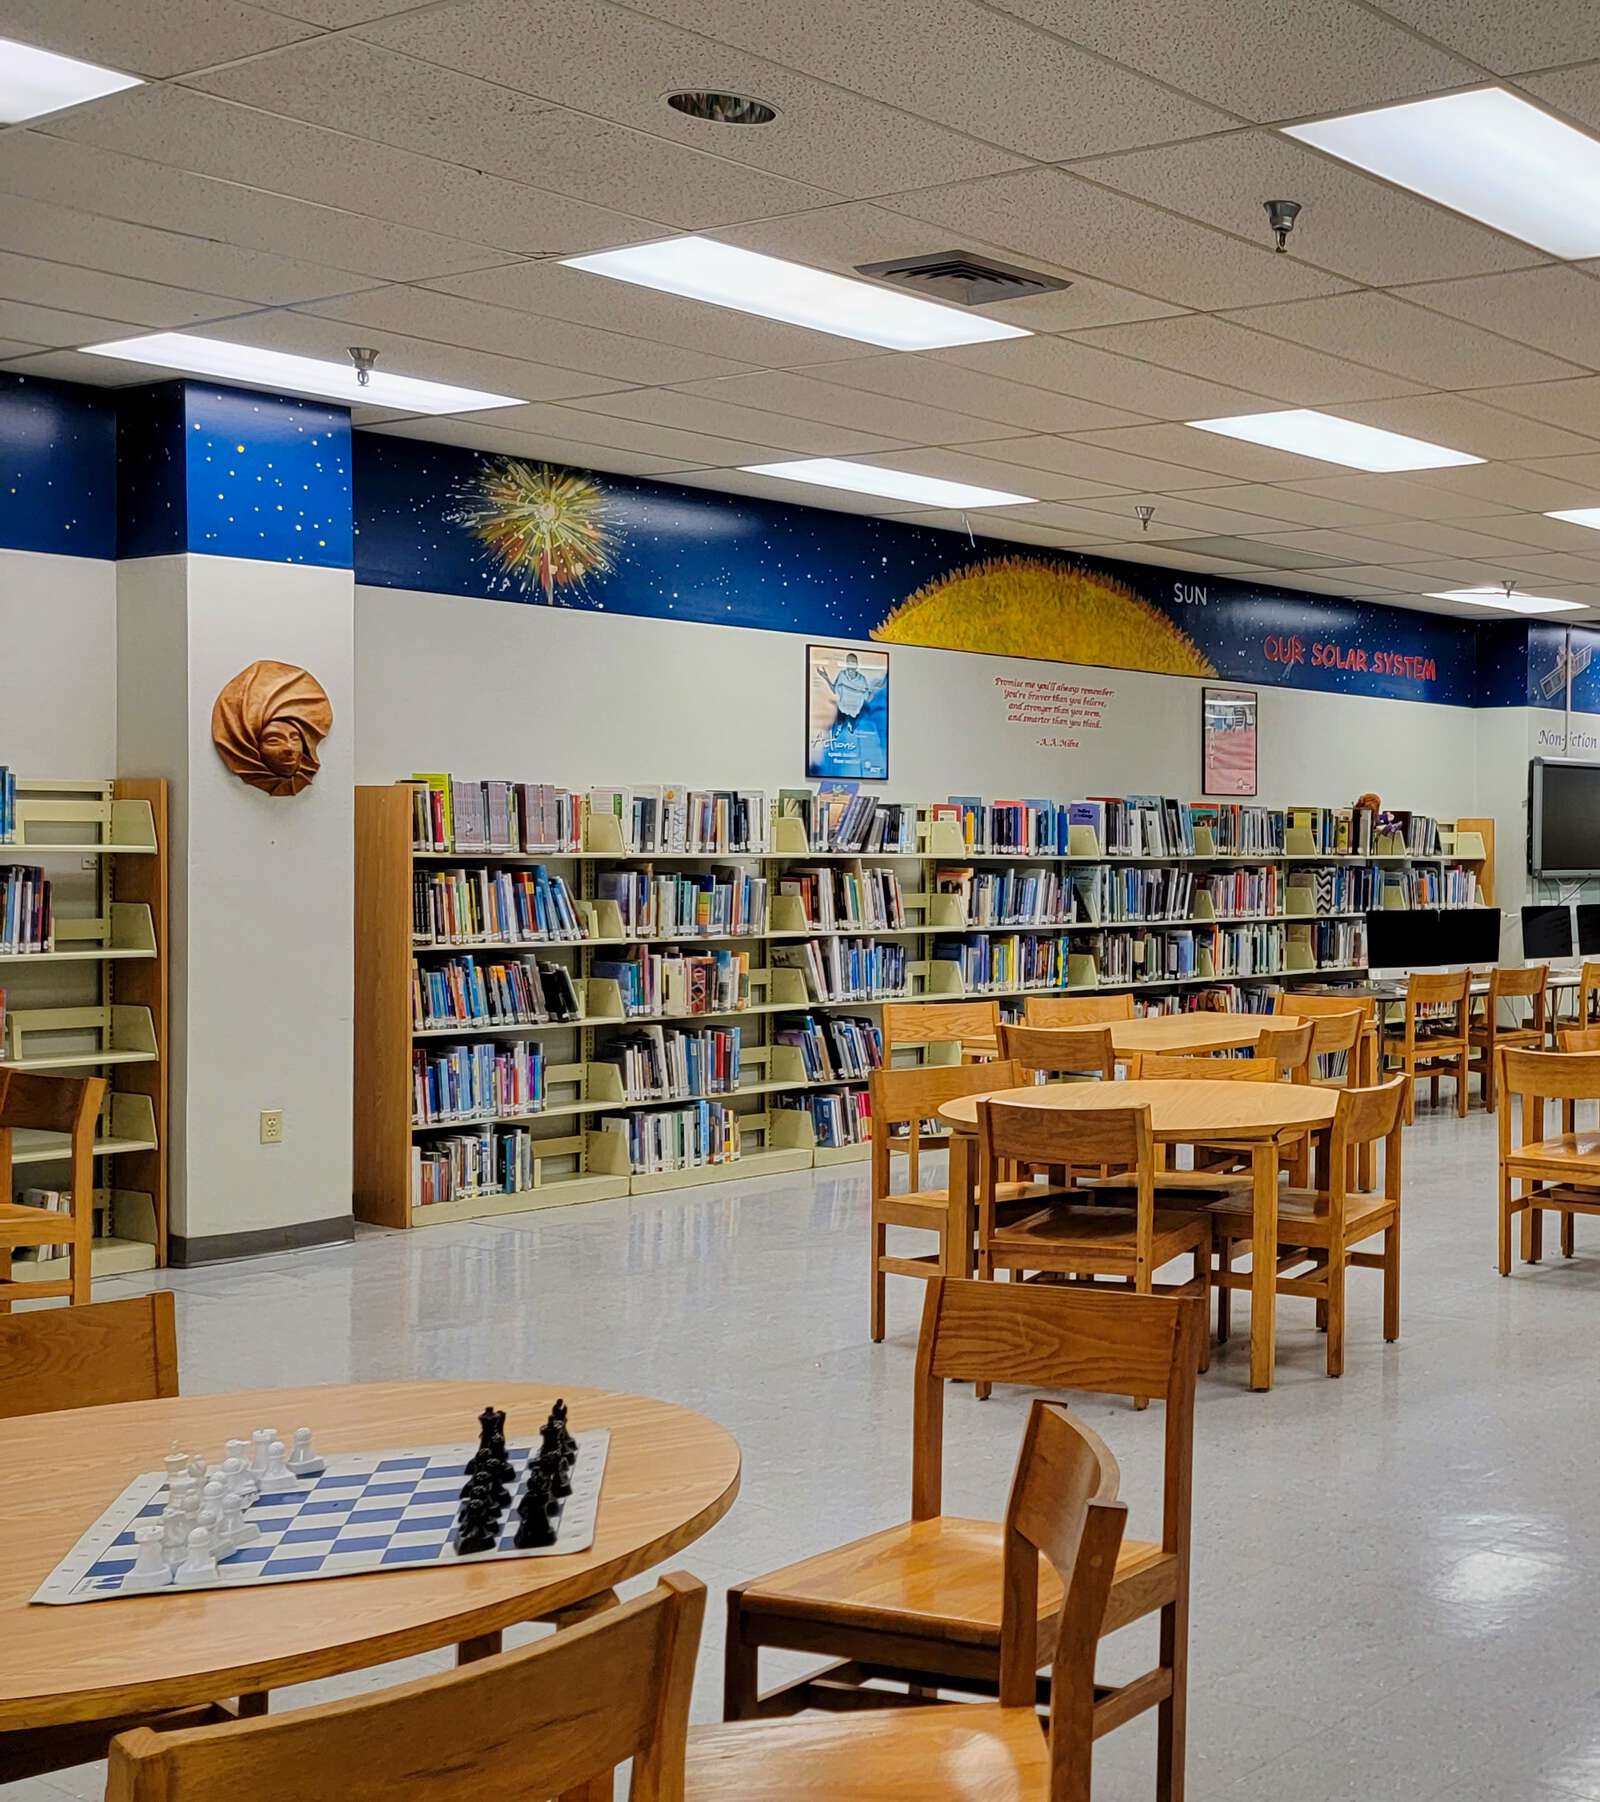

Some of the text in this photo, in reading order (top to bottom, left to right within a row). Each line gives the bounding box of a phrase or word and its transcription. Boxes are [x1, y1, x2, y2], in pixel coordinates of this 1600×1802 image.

[1173, 582, 1208, 606] SUN
[1263, 633, 1437, 681] OUR SOLAR SYSTEM
[994, 677, 1024, 688] Promise
[1037, 681, 1056, 692] you'll
[1056, 683, 1080, 695] always
[1053, 694, 1068, 703] than
[1069, 697, 1082, 707] you
[1008, 702, 1024, 710] and
[1023, 704, 1053, 715] stronger
[1053, 706, 1069, 714] than
[1070, 708, 1083, 718] you
[1008, 713, 1024, 722] and
[1023, 716, 1051, 724] smarter
[1052, 717, 1068, 725] than
[1068, 719, 1082, 729] you
